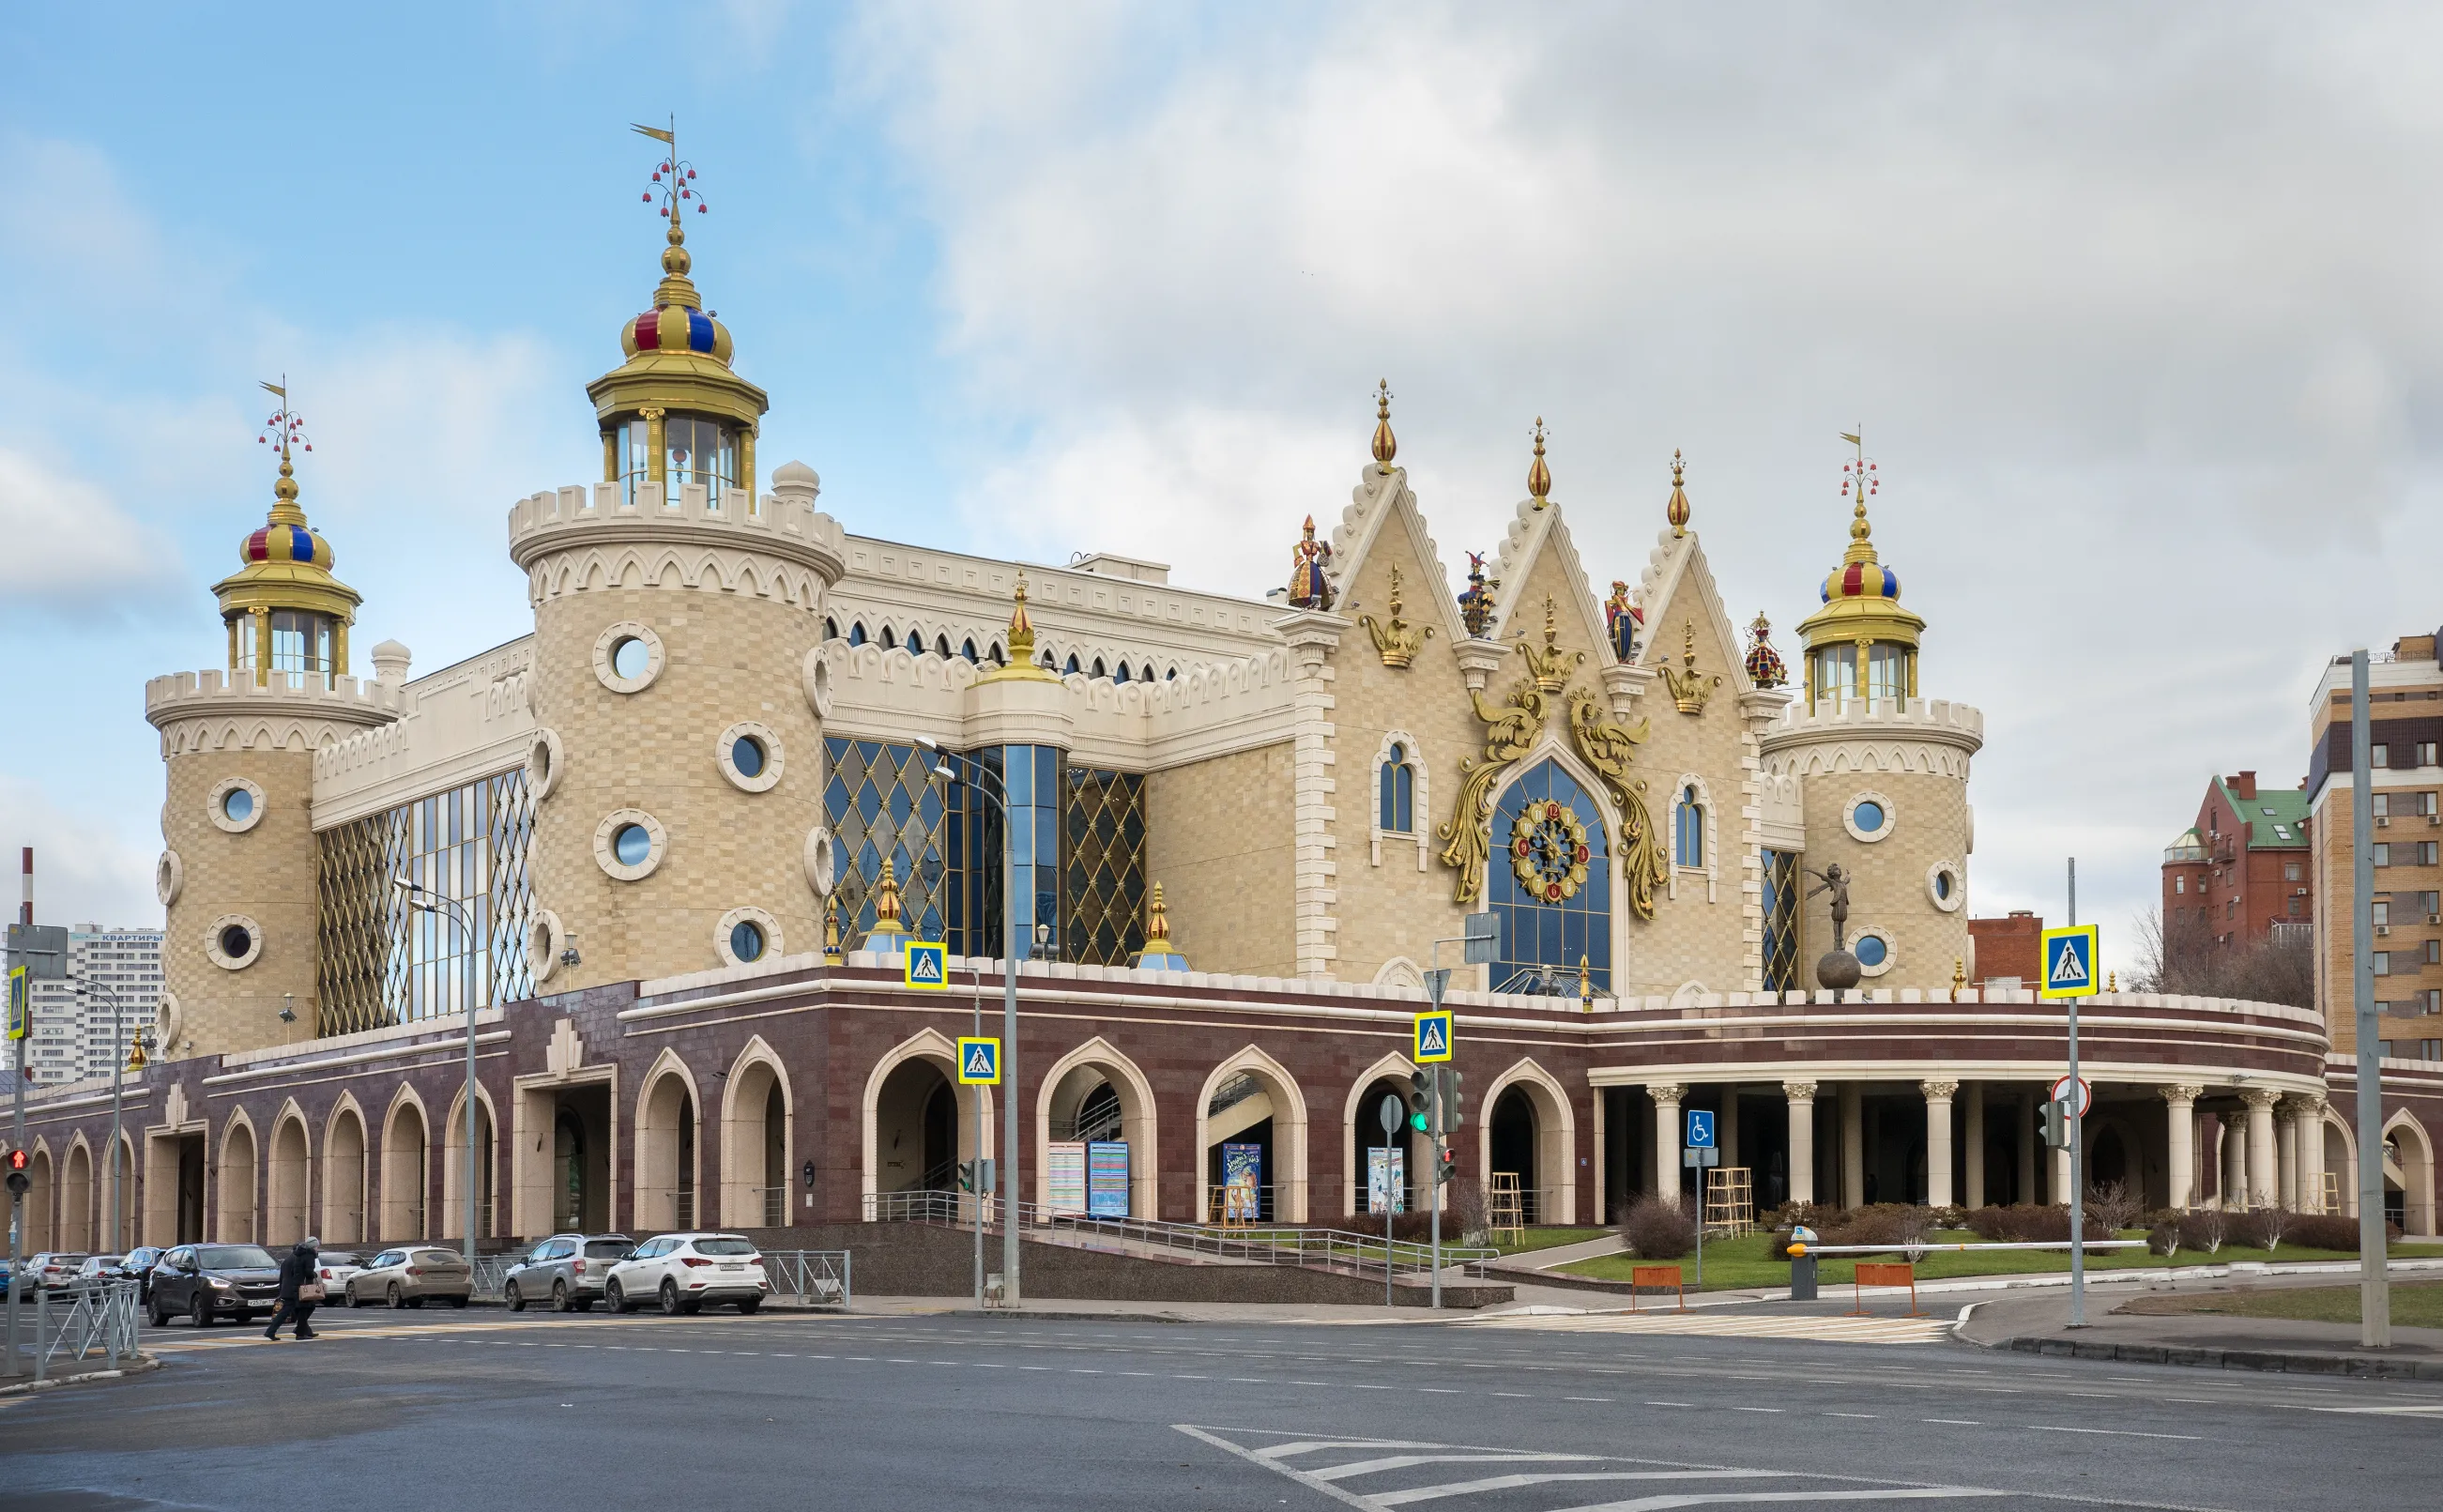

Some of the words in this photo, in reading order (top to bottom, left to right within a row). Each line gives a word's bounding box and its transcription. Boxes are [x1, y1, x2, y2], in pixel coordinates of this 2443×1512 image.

[1535, 810, 1542, 820] 11
[1549, 806, 1558, 817] 12
[1565, 813, 1570, 824] 1
[1524, 822, 1532, 833] 10
[1576, 828, 1581, 838] 2
[1521, 843, 1527, 853] 9
[1580, 849, 1585, 859] 3
[1525, 863, 1531, 873] 8
[1535, 878, 1541, 889] 7
[1566, 881, 1572, 893] 5
[1551, 886, 1557, 896] 6
